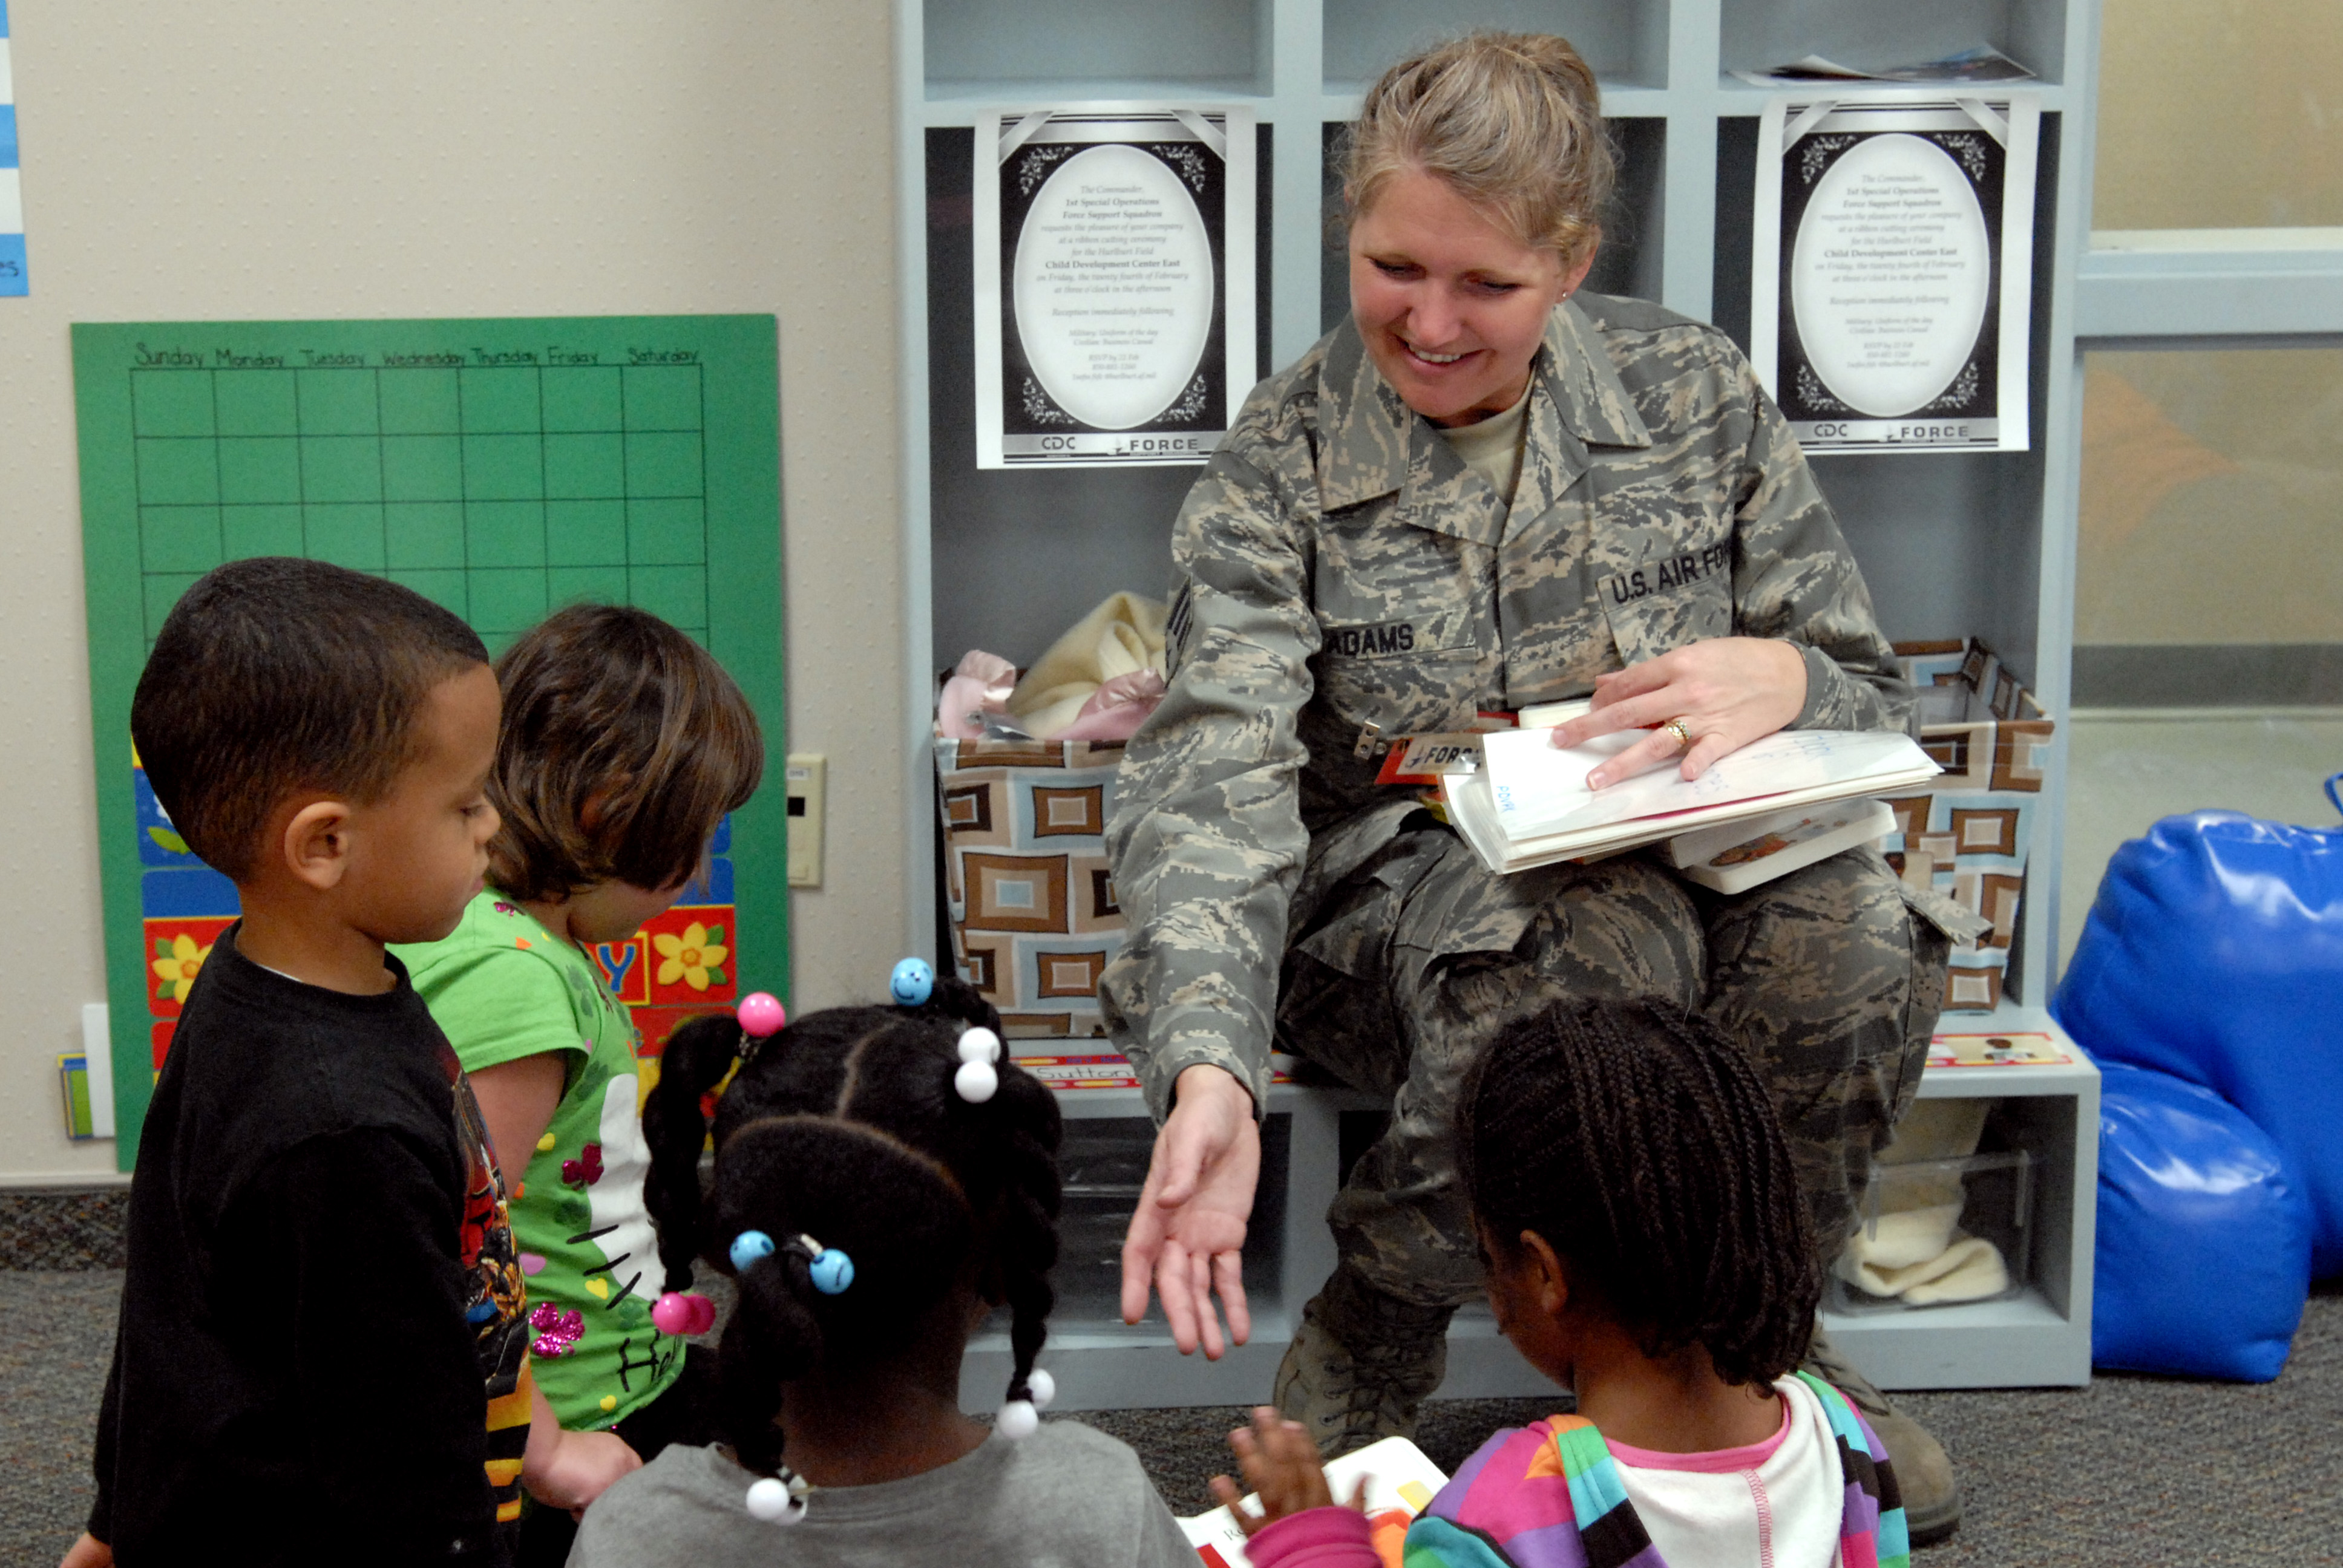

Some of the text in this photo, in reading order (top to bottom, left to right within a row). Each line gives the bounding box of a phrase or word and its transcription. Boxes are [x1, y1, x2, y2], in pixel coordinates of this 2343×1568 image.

[1081, 198, 1110, 207] Special
[1113, 198, 1159, 207] Operations
[1088, 211, 1120, 220] Support
[1123, 211, 1162, 220] Squadron
[1851, 249, 1908, 259] Development
[1072, 261, 1130, 270] Development
[135, 342, 204, 368] Sunday
[215, 348, 285, 367] Monday
[382, 348, 465, 367] Wednesday
[471, 347, 539, 365] Thursday
[548, 346, 598, 364] Friday
[628, 347, 700, 365] Saturday
[1815, 424, 1847, 437] CDC
[1901, 426, 1968, 437] FORCE
[1041, 437, 1075, 449] CDC
[1130, 439, 1198, 451] FORCE
[1611, 571, 1654, 604] U.S.
[1659, 555, 1700, 590] AIR
[1327, 623, 1414, 656] ADAMS
[1037, 1067, 1130, 1079] Sutton
